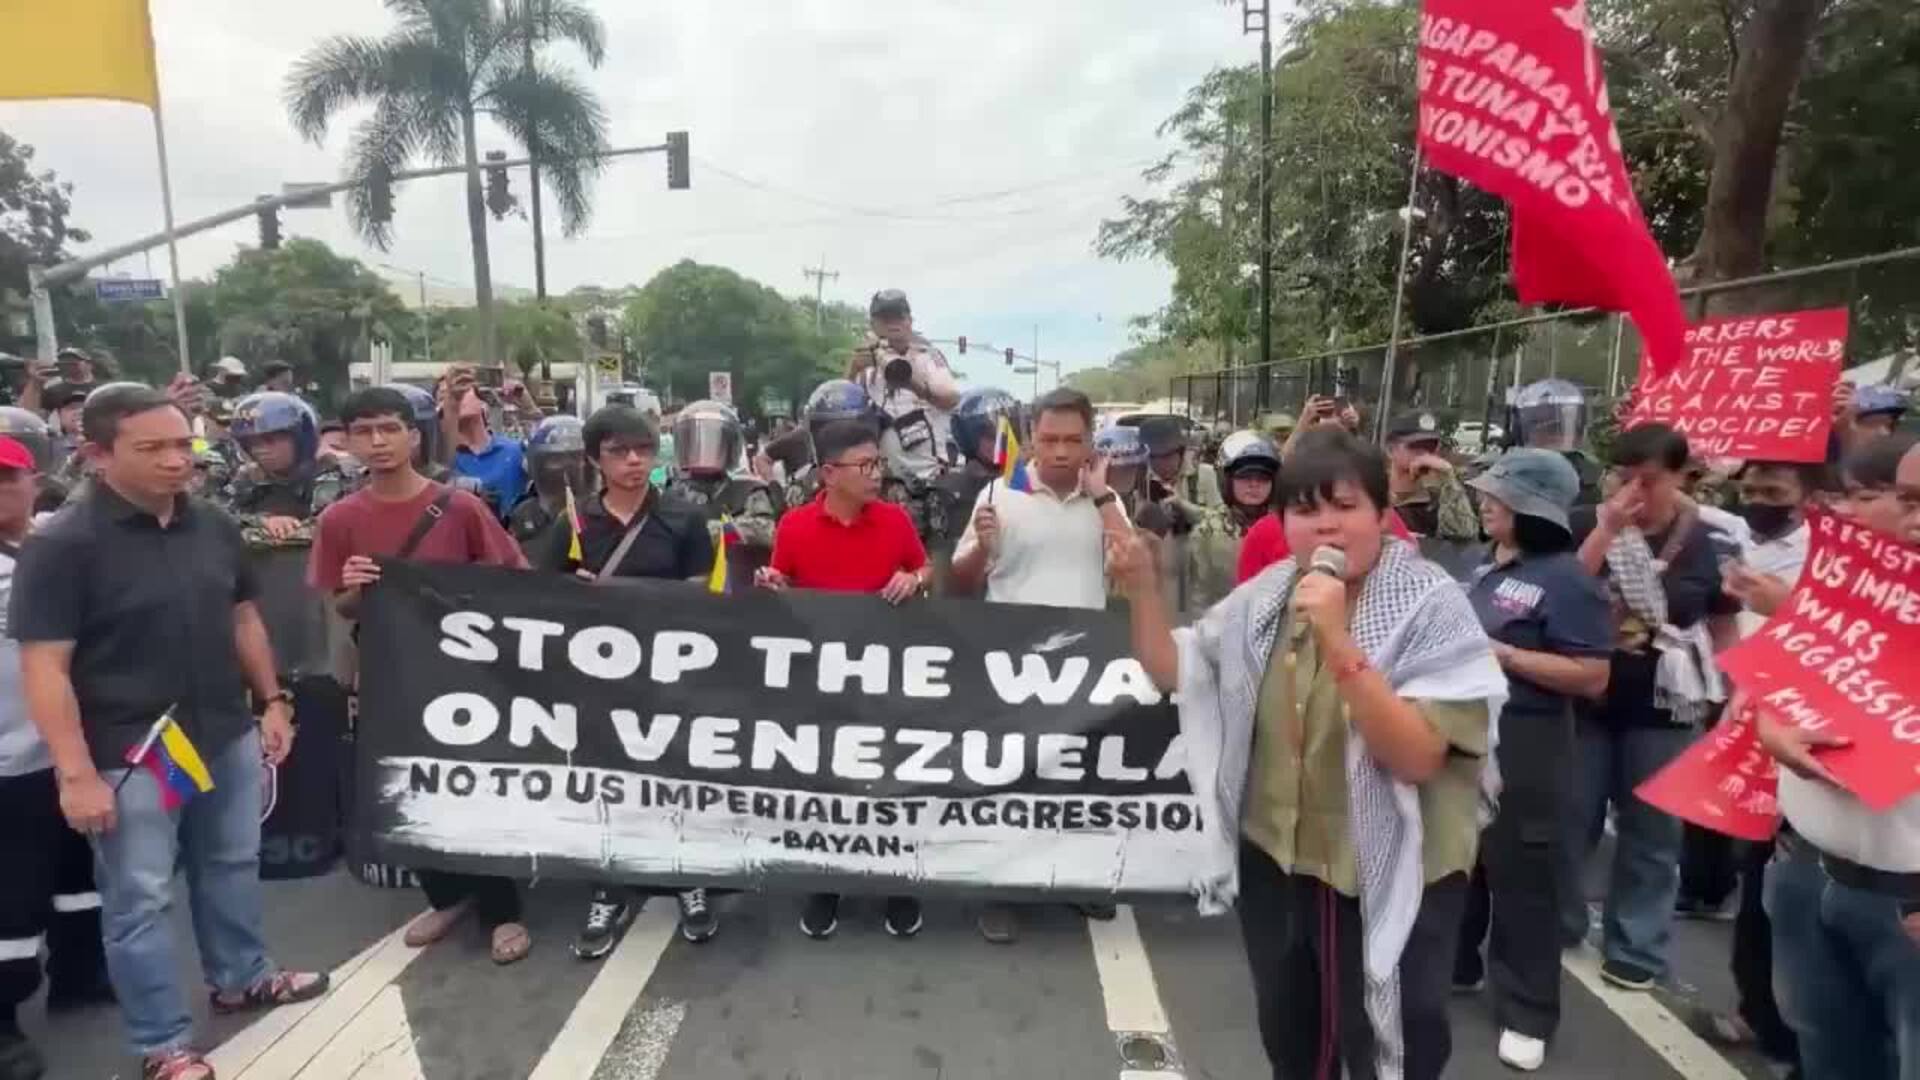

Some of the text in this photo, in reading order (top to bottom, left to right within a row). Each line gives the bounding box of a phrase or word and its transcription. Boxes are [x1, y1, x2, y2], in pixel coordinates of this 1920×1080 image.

[1690, 346, 1745, 369] THE
[1624, 416, 1822, 440] NOCIDE!
[1633, 393, 1817, 413] AGAINST
[1811, 547, 1851, 588] US
[1795, 587, 1888, 662] WARS
[439, 611, 1163, 705] STOP THE WA
[422, 692, 578, 752] ON
[409, 763, 1203, 832] NO TO US IMPERIALIST AGGRESSIO
